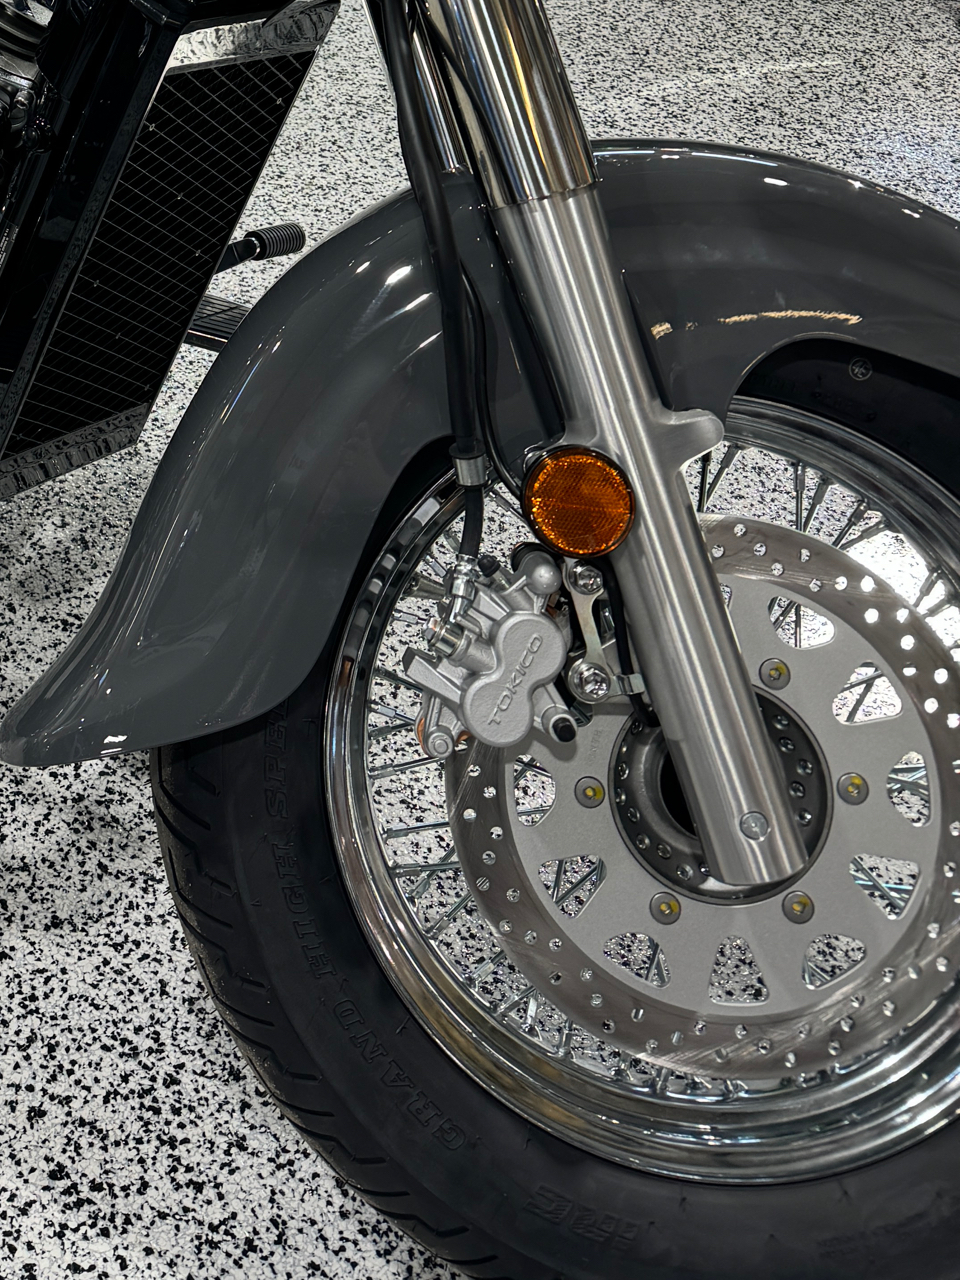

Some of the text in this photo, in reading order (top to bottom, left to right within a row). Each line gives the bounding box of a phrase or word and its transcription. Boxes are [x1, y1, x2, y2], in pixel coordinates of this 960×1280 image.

[488, 632, 544, 726] TOKICO
[262, 696, 467, 1151] GRAND HIGH SPE
